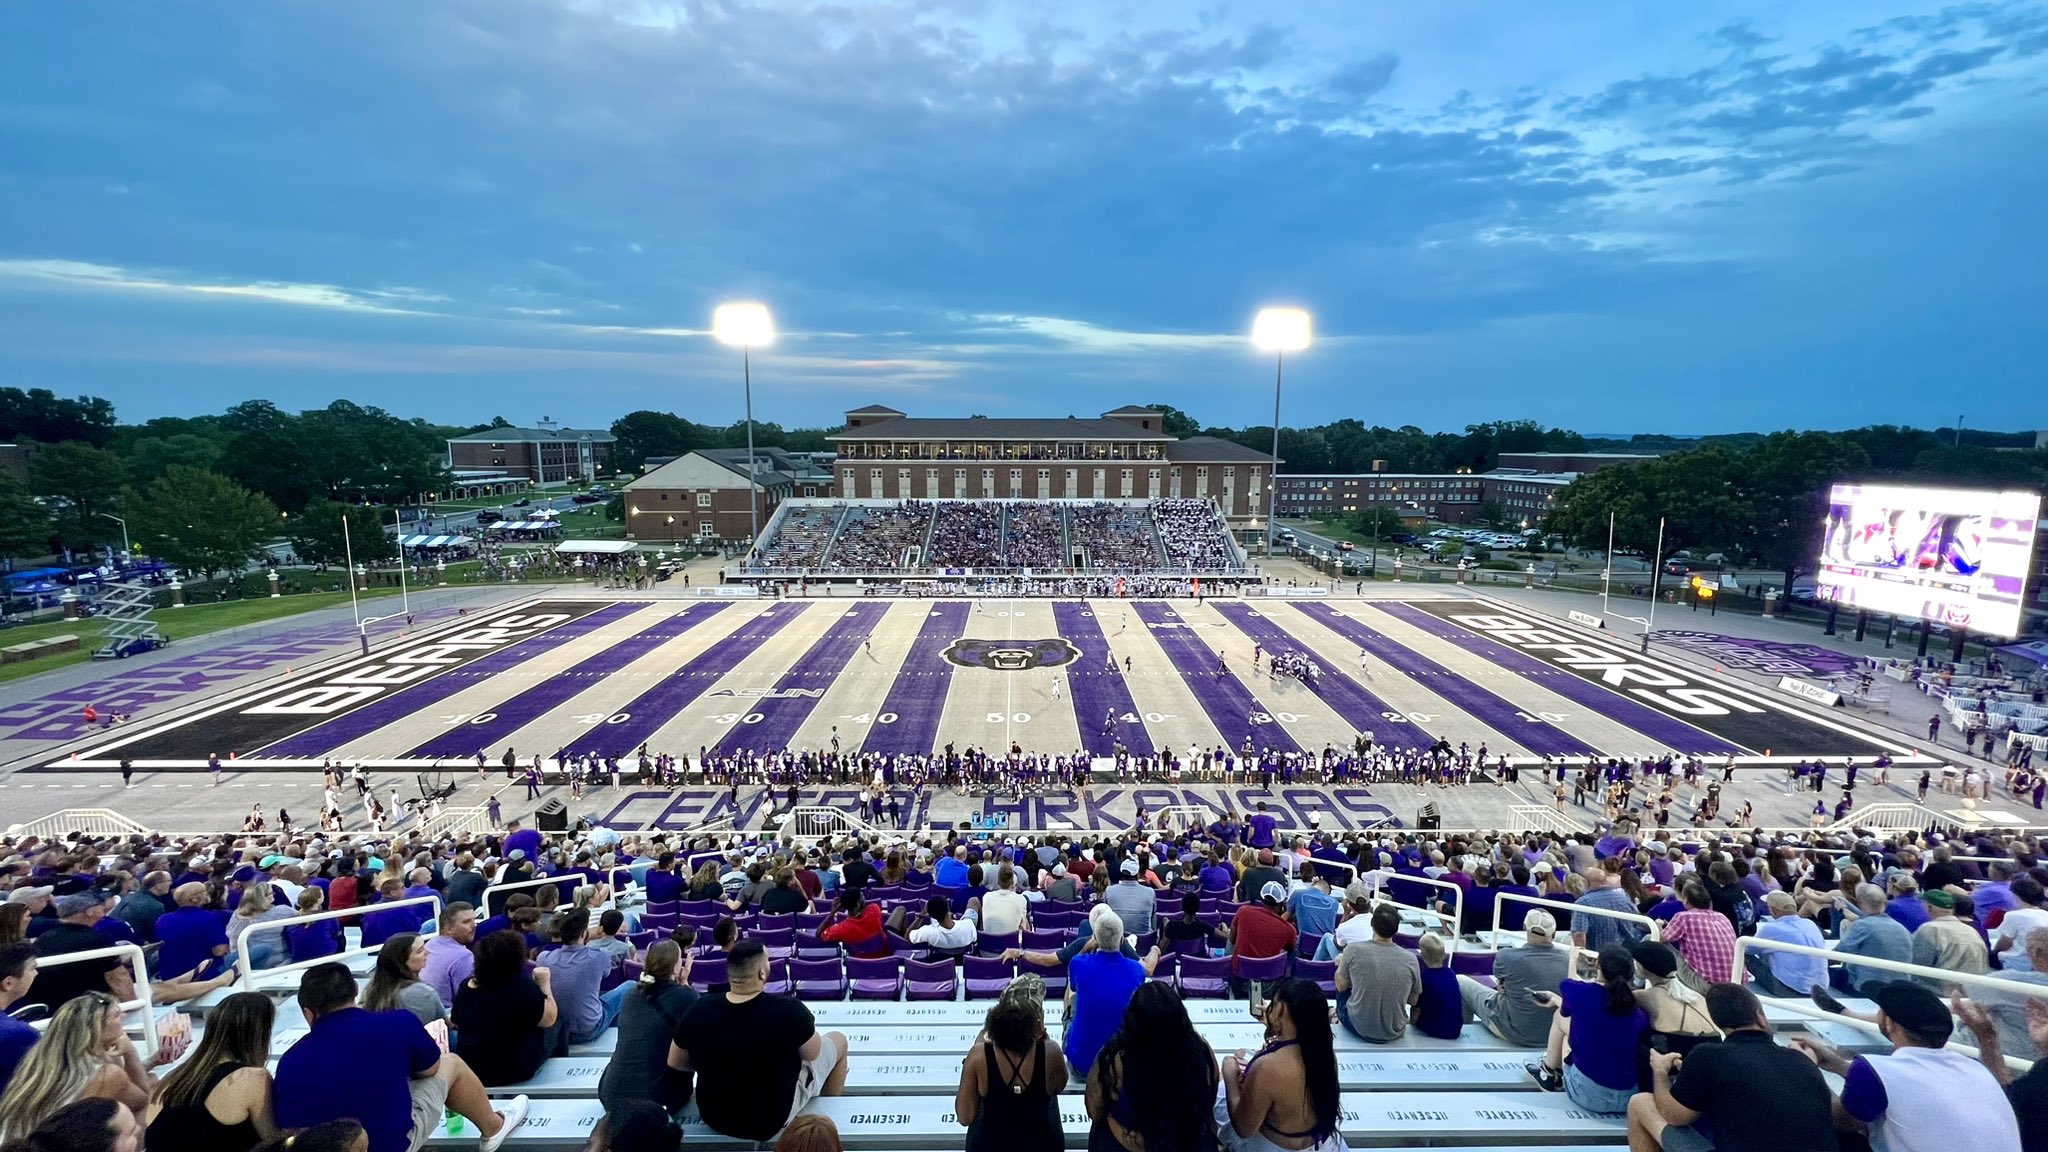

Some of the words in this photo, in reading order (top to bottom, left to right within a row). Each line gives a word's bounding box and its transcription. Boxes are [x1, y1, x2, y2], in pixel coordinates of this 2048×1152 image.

[239, 613, 572, 714] BEARS
[1448, 615, 1767, 715] BEARS
[706, 688, 825, 698] ASUN
[443, 713, 498, 724] 10
[576, 713, 631, 724] 20
[714, 713, 764, 724] 30
[848, 713, 898, 724] 40
[985, 712, 1031, 723] 50
[1119, 712, 1166, 723] 40
[1254, 712, 1300, 723] 30
[1381, 711, 1433, 723] 20
[850, 1114, 911, 1124] RESERVED
[1387, 1111, 1449, 1121] RESERVED
[1475, 1110, 1537, 1120] RESERVED
